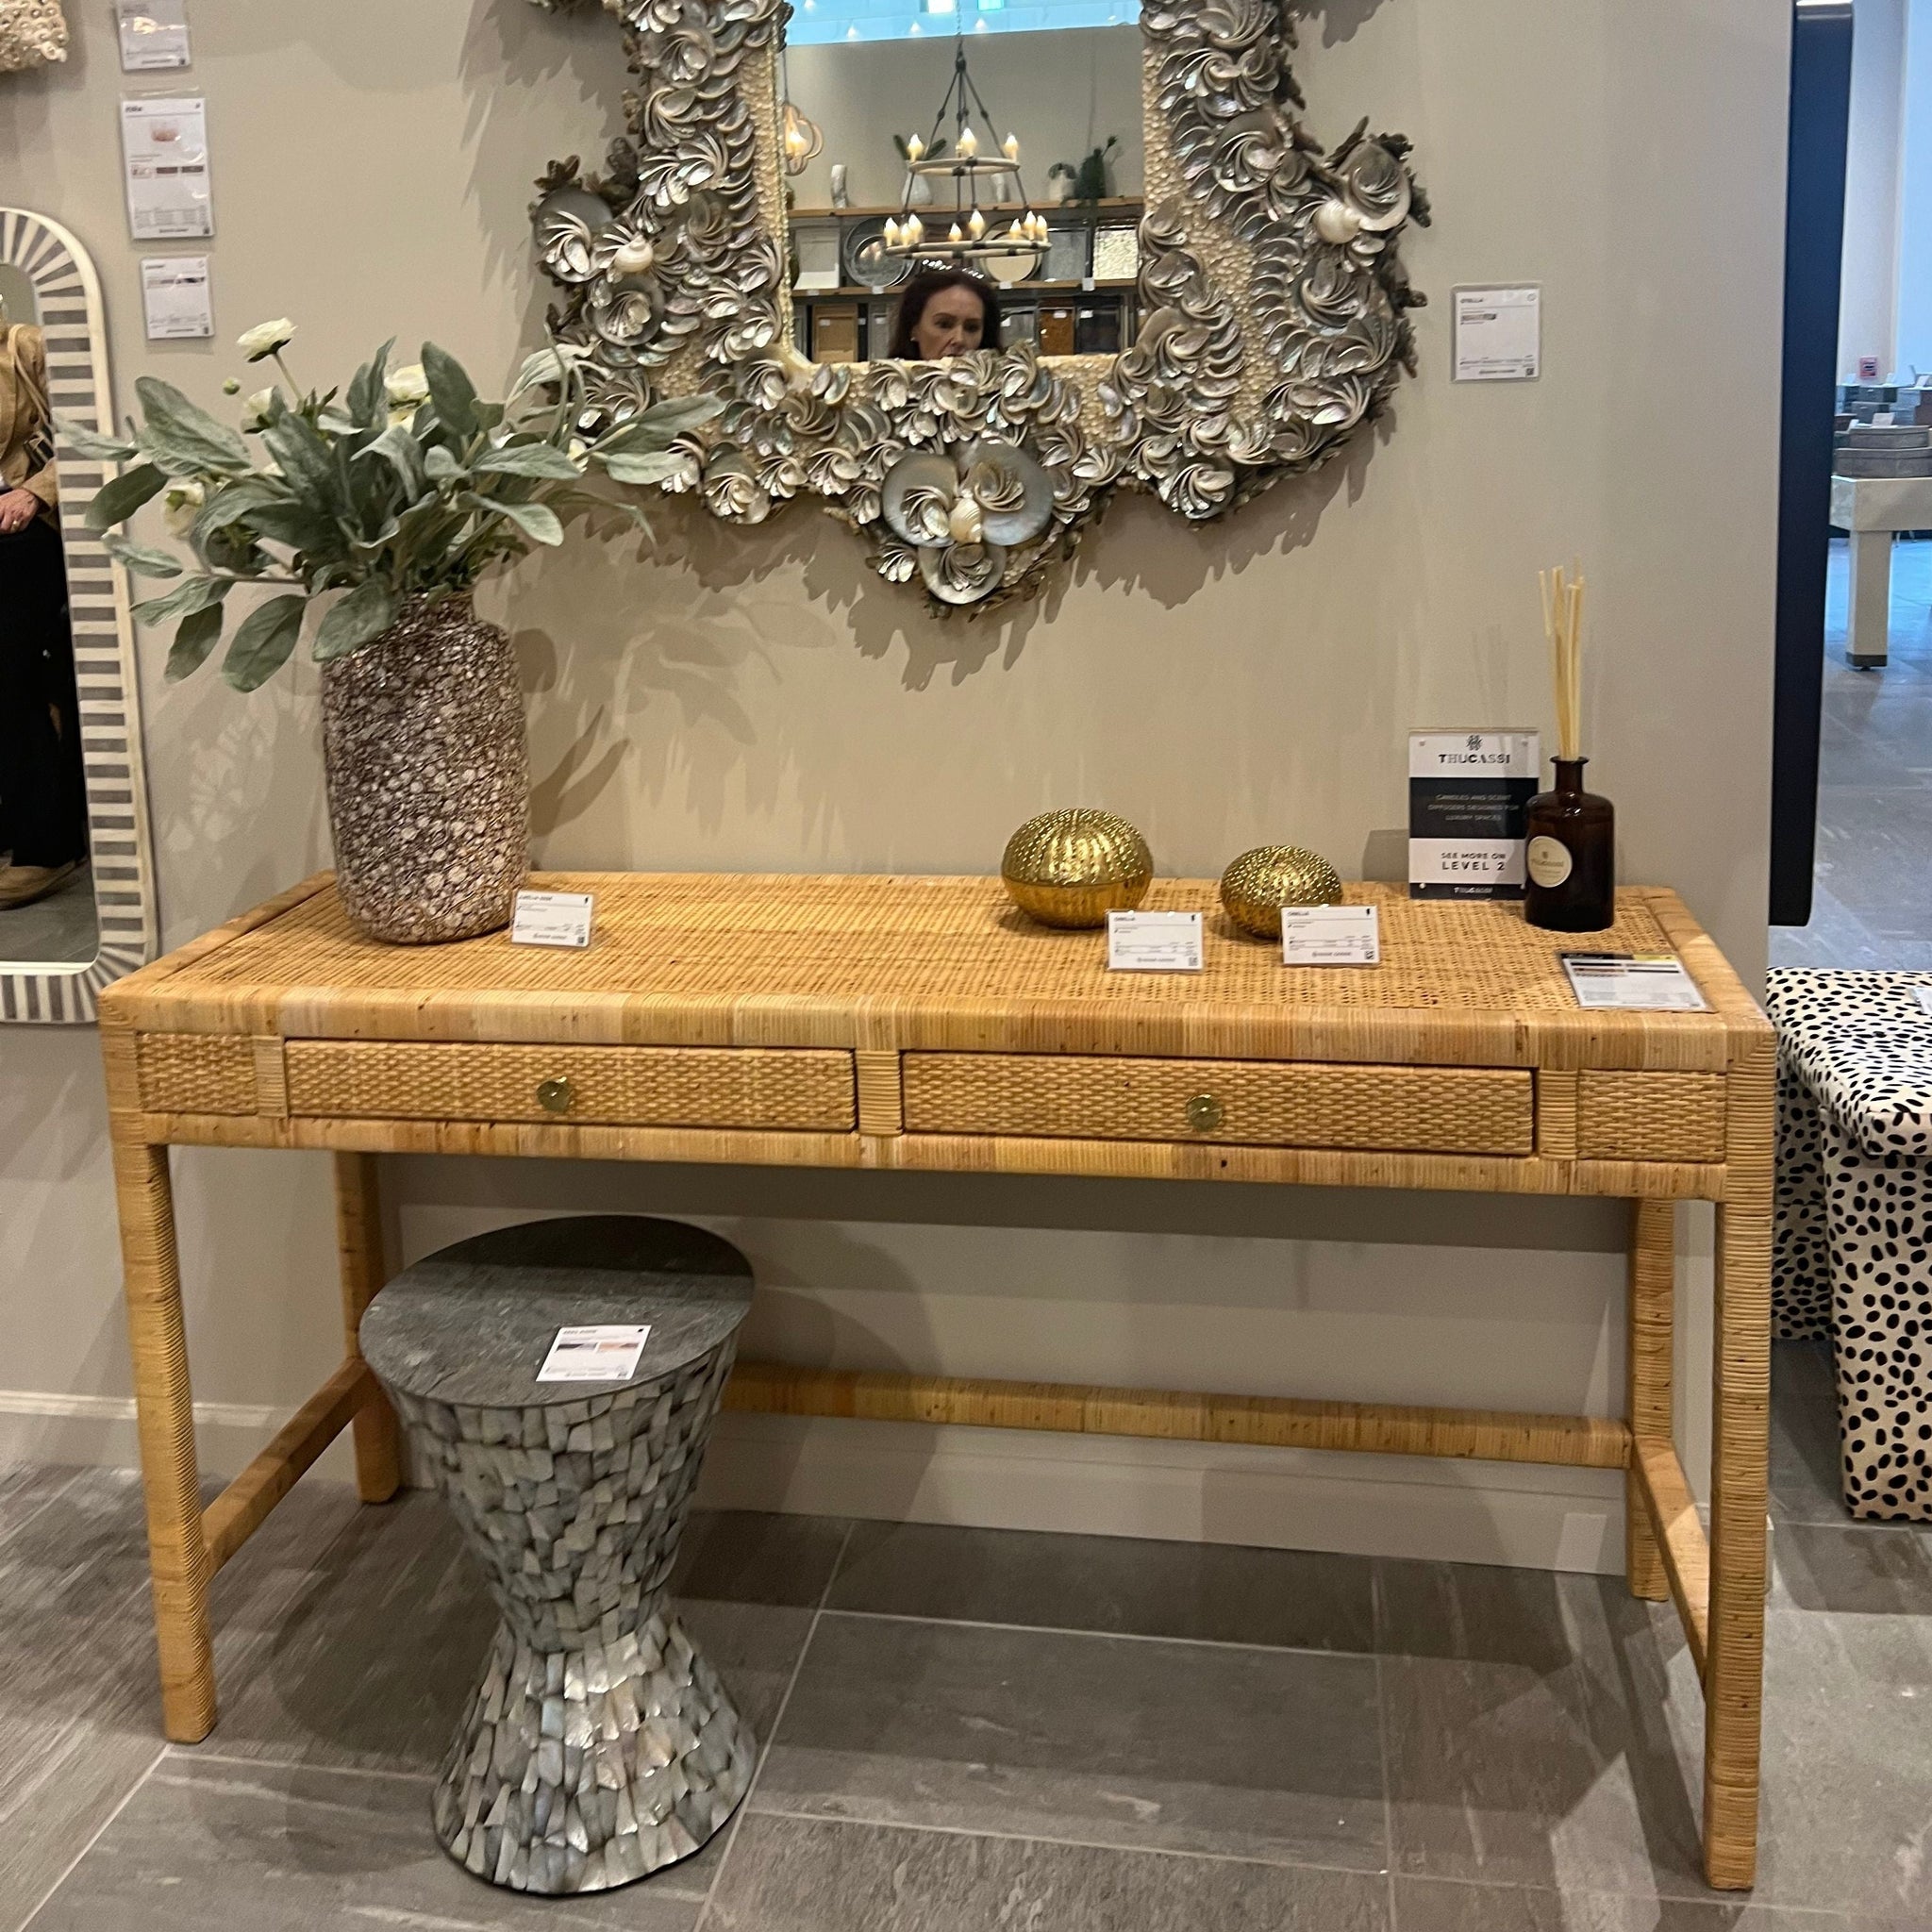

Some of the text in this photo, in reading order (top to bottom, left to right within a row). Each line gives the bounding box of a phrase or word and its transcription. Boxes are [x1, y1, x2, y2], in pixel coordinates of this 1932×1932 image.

[1439, 754, 1510, 764] THUCASSI
[1441, 861, 1506, 871] LEVEL 2
